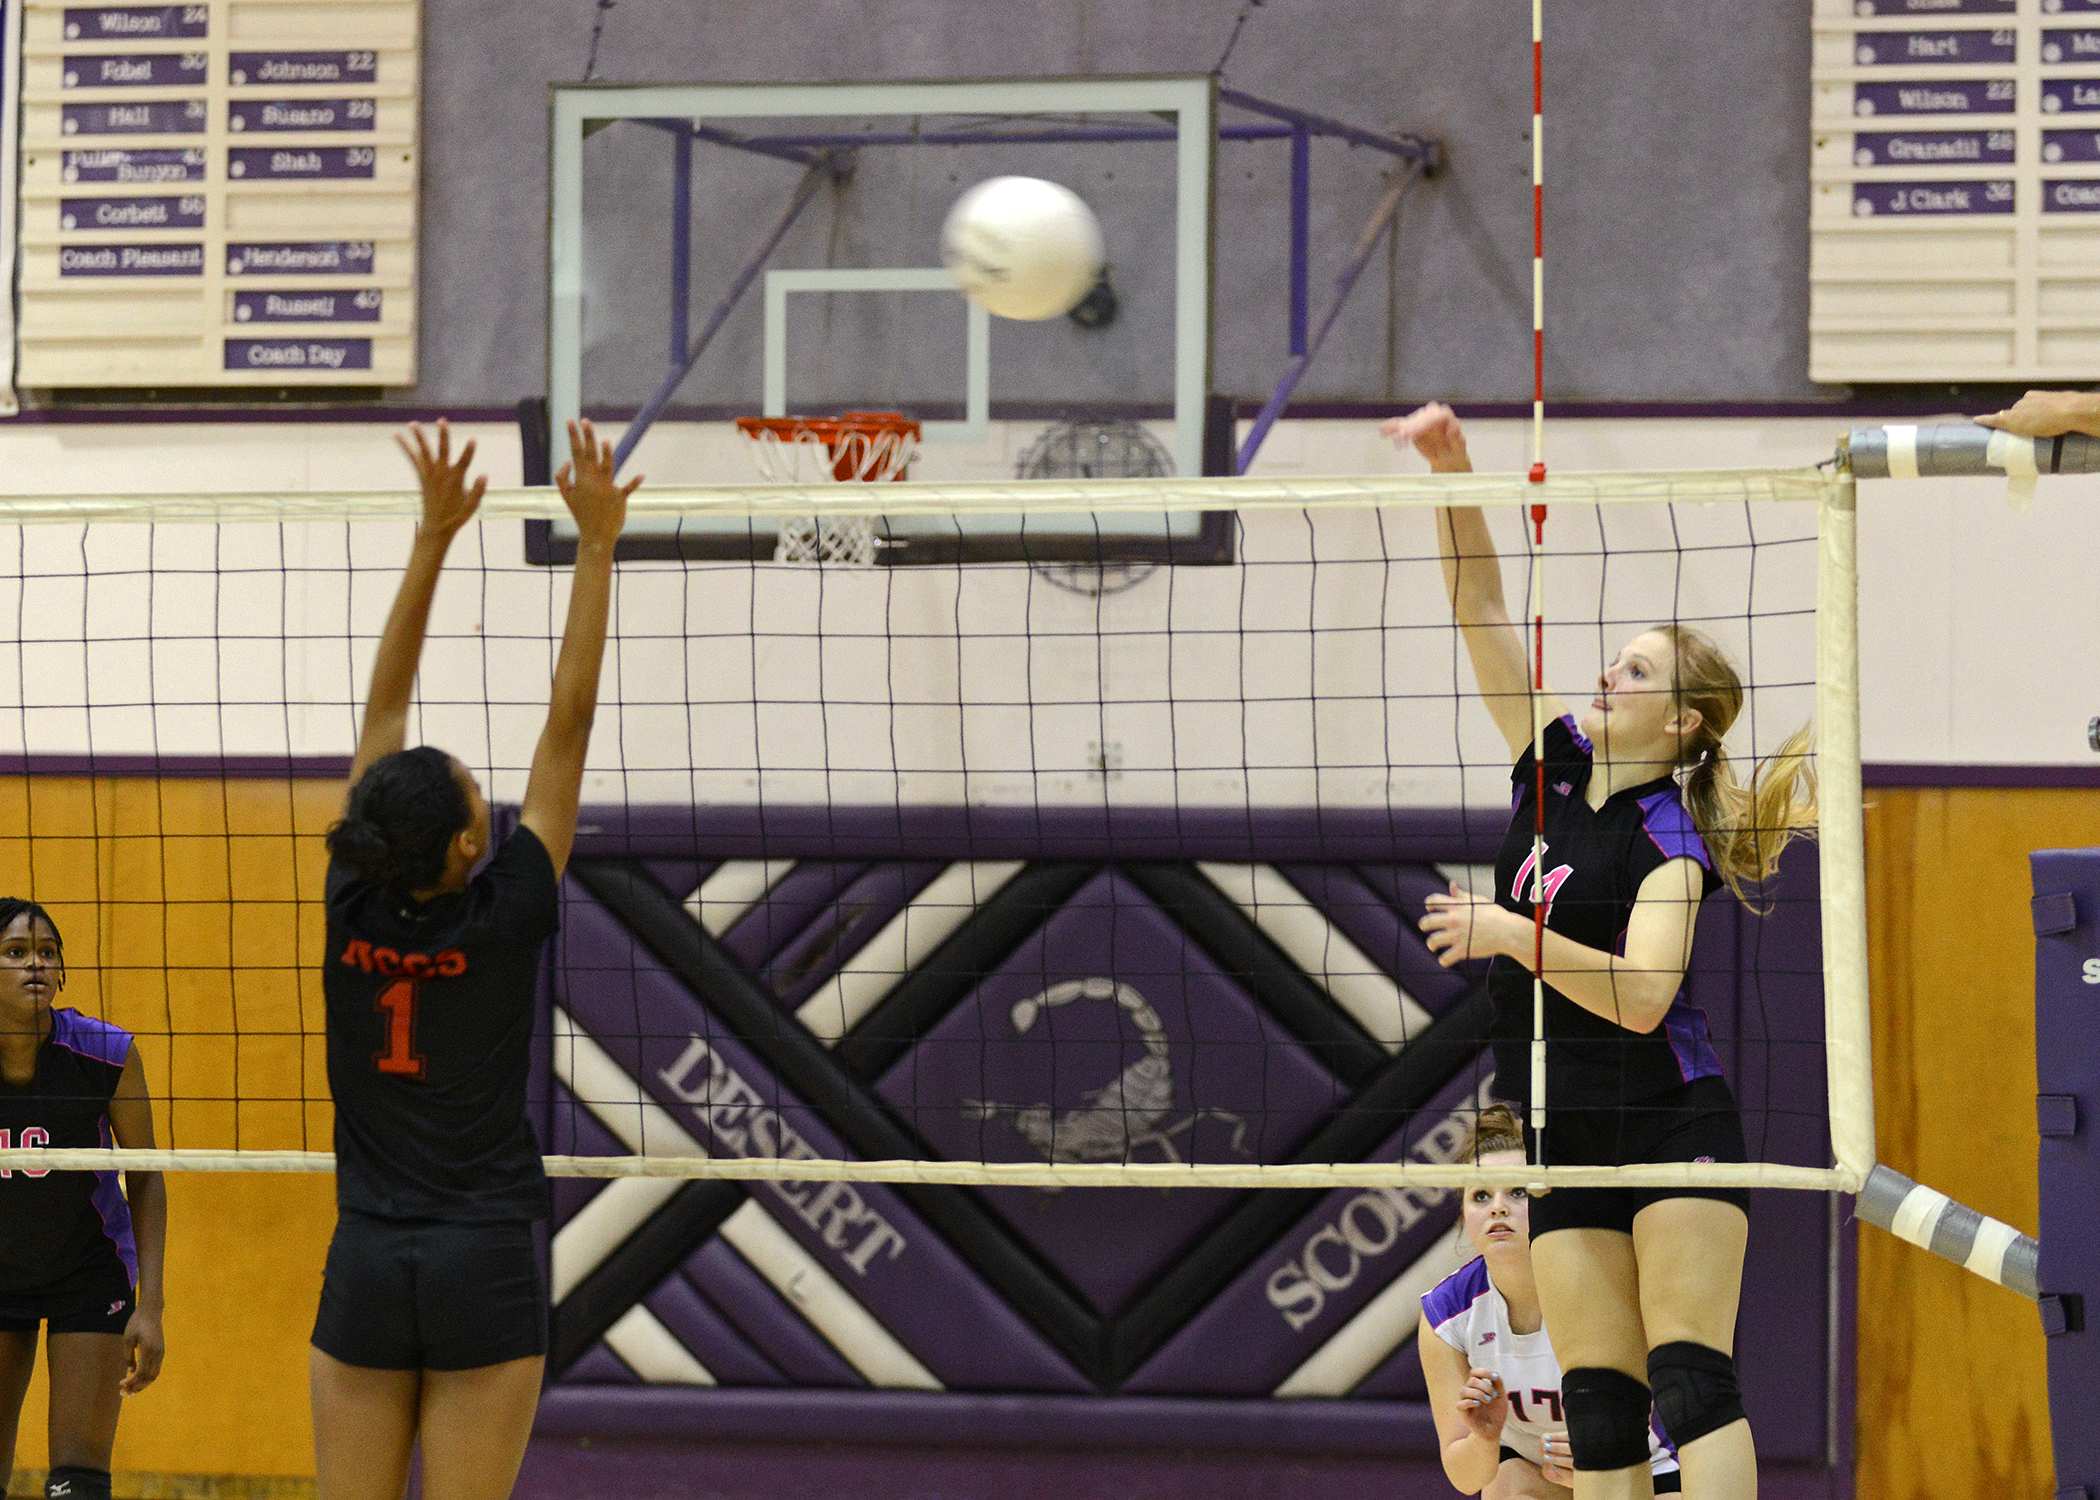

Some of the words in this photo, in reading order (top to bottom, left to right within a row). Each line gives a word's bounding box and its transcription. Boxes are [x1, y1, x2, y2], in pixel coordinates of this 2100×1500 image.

[100, 12, 161, 32] Wilson
[1908, 36, 1959, 55] Hart
[258, 60, 340, 80] Johnson
[346, 51, 376, 71] 22
[1899, 89, 1969, 110] Wilson
[96, 203, 168, 224] Corbett
[62, 248, 117, 269] Coach
[121, 248, 202, 269] Pleasant
[243, 247, 340, 267] Henderson
[266, 295, 335, 317] Russell
[248, 344, 306, 366] Coach
[308, 344, 347, 367] Day
[375, 980, 422, 1075] 1
[658, 1031, 906, 1276] DESERT
[1507, 1388, 1563, 1422] 17
